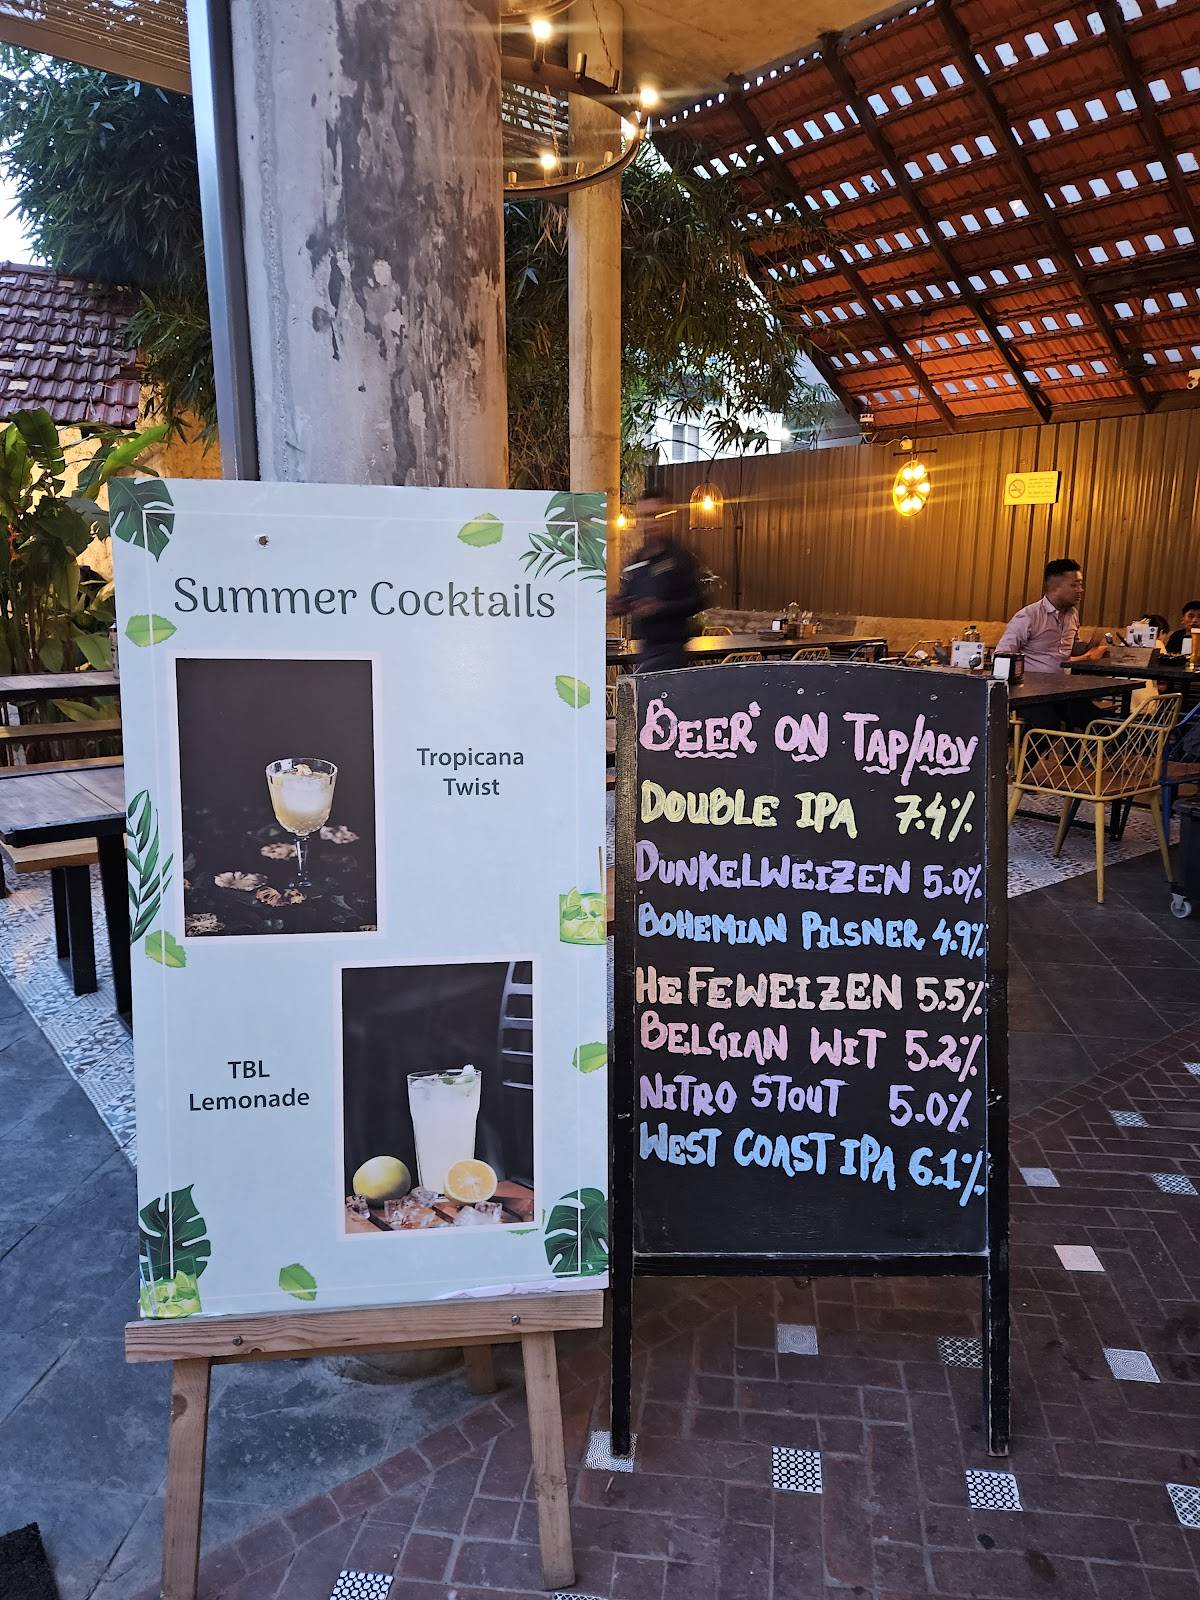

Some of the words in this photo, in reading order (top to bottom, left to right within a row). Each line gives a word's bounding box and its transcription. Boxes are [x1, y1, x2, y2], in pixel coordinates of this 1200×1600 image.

[173, 577, 357, 616] Summer
[370, 580, 556, 618] Cocktails
[416, 747, 524, 771] Tropicana
[774, 712, 829, 762] ON
[442, 777, 500, 796] Twist
[641, 780, 780, 828] DOUBLE
[794, 791, 858, 839] IPA
[893, 790, 976, 842] 7.4%
[635, 839, 911, 896] DUNKELWEIZEN
[922, 863, 984, 904] 5.0%
[638, 902, 788, 947] BOHEMIAN
[801, 911, 926, 951] PILSNER
[931, 918, 988, 960] 4.9%
[635, 965, 903, 1011] HEFEWEIZEN
[915, 976, 988, 1023] 5.5%
[227, 1060, 270, 1079] TBL
[640, 1010, 789, 1066] BELGIAN
[810, 1027, 887, 1069] WIT
[905, 1029, 983, 1083] 5.2%
[189, 1087, 310, 1111] Lemonade
[639, 1072, 738, 1117] NITRO
[888, 1084, 973, 1133] 5.0%
[639, 1121, 723, 1168] WEST
[733, 1127, 836, 1178] COAST
[839, 1134, 897, 1191] IPA
[908, 1146, 988, 1207] 6.1%
